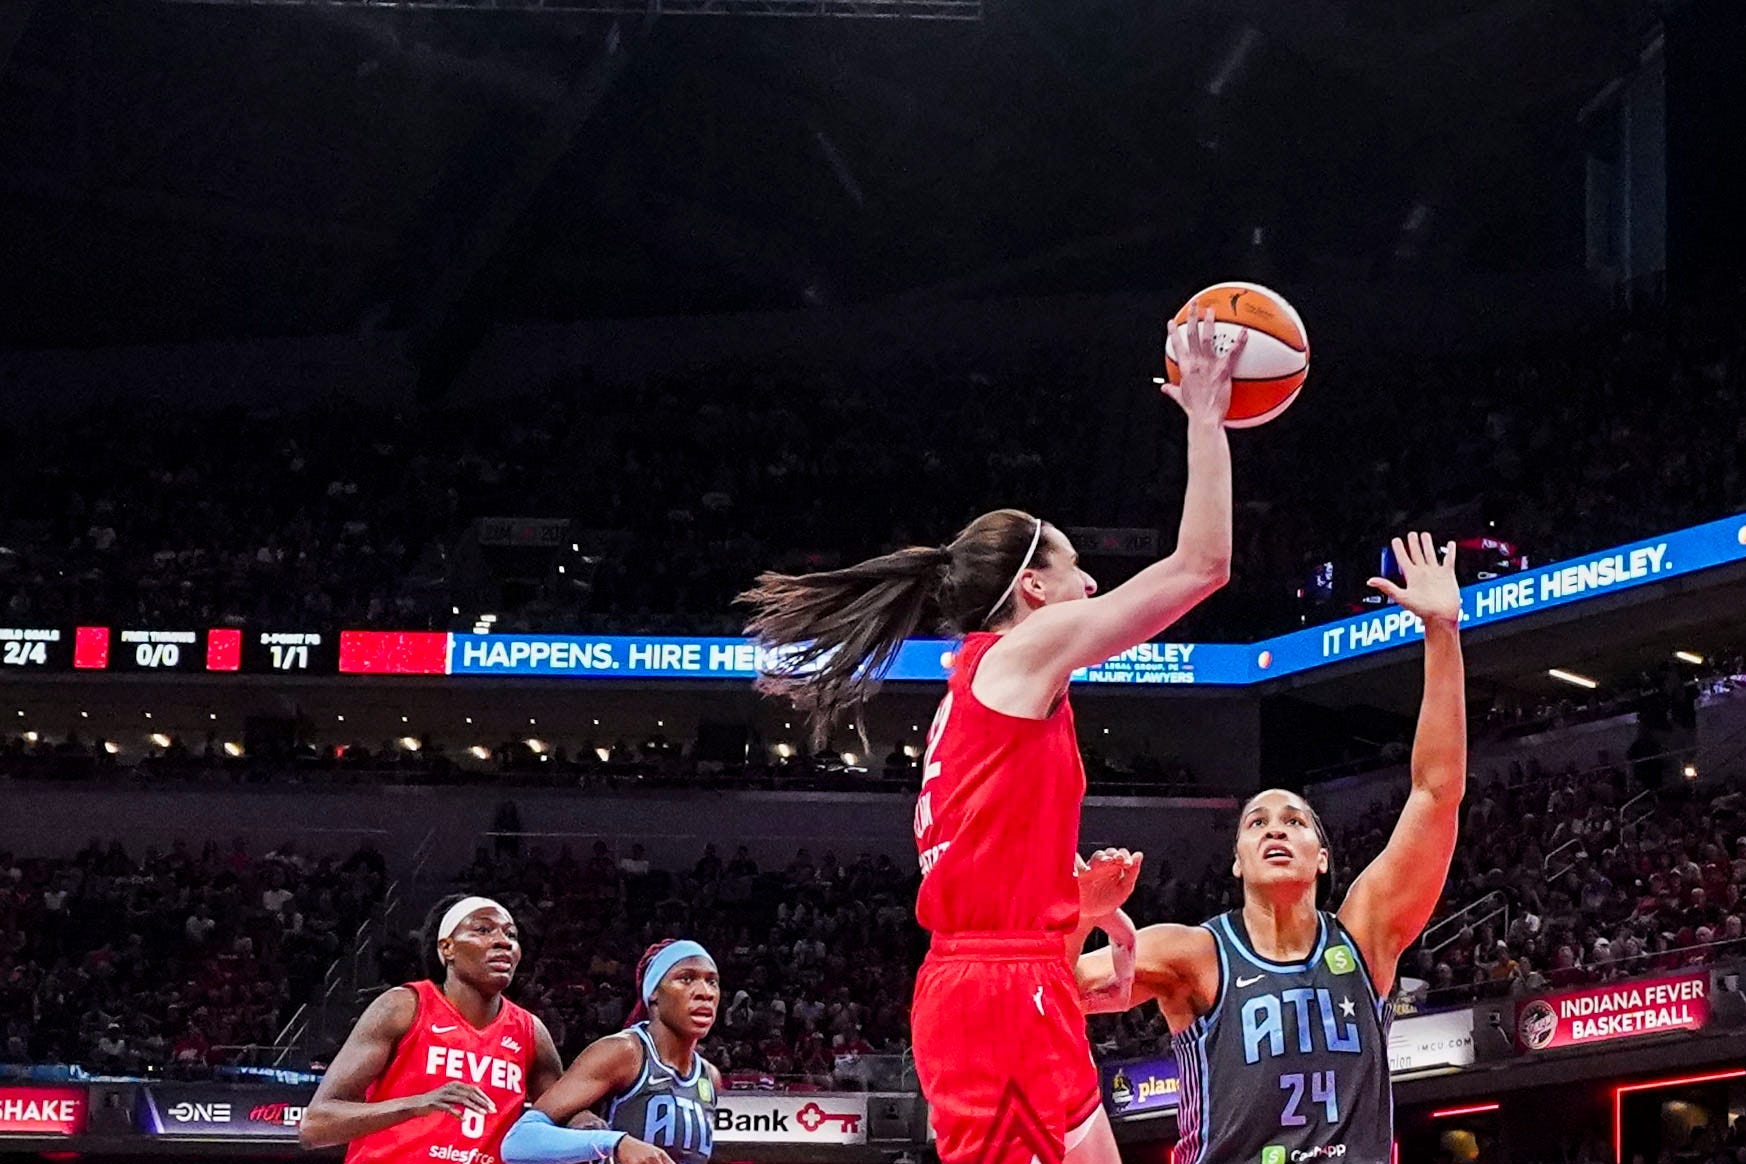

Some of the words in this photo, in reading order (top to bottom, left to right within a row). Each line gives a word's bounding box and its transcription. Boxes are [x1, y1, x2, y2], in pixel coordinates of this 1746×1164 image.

[1322, 628, 1346, 657] IT
[1349, 600, 1470, 650] HAPPE.
[1476, 578, 1535, 618] HIRE
[1540, 543, 1674, 599] HENSLEY.
[3, 641, 47, 665] 2/4
[135, 643, 180, 667] 0/0
[269, 645, 309, 669] 1/1
[464, 641, 620, 670] HAPPENS.
[628, 643, 701, 671] HIRE
[1106, 643, 1195, 663] NSLEY
[1089, 671, 1134, 682] INJURY
[1135, 671, 1195, 684] LAWYERS
[1561, 990, 1640, 1019] INDIANA
[1645, 979, 1704, 1006] FEVER
[1242, 988, 1361, 1063] ATL
[1572, 1005, 1693, 1040] BASKETBALL
[426, 1045, 522, 1094] FEVER
[1388, 1054, 1412, 1070] nion
[1279, 1069, 1339, 1127] 24
[168, 1103, 231, 1122] ONE
[461, 1107, 485, 1139] 0
[713, 1108, 789, 1132] Bank
